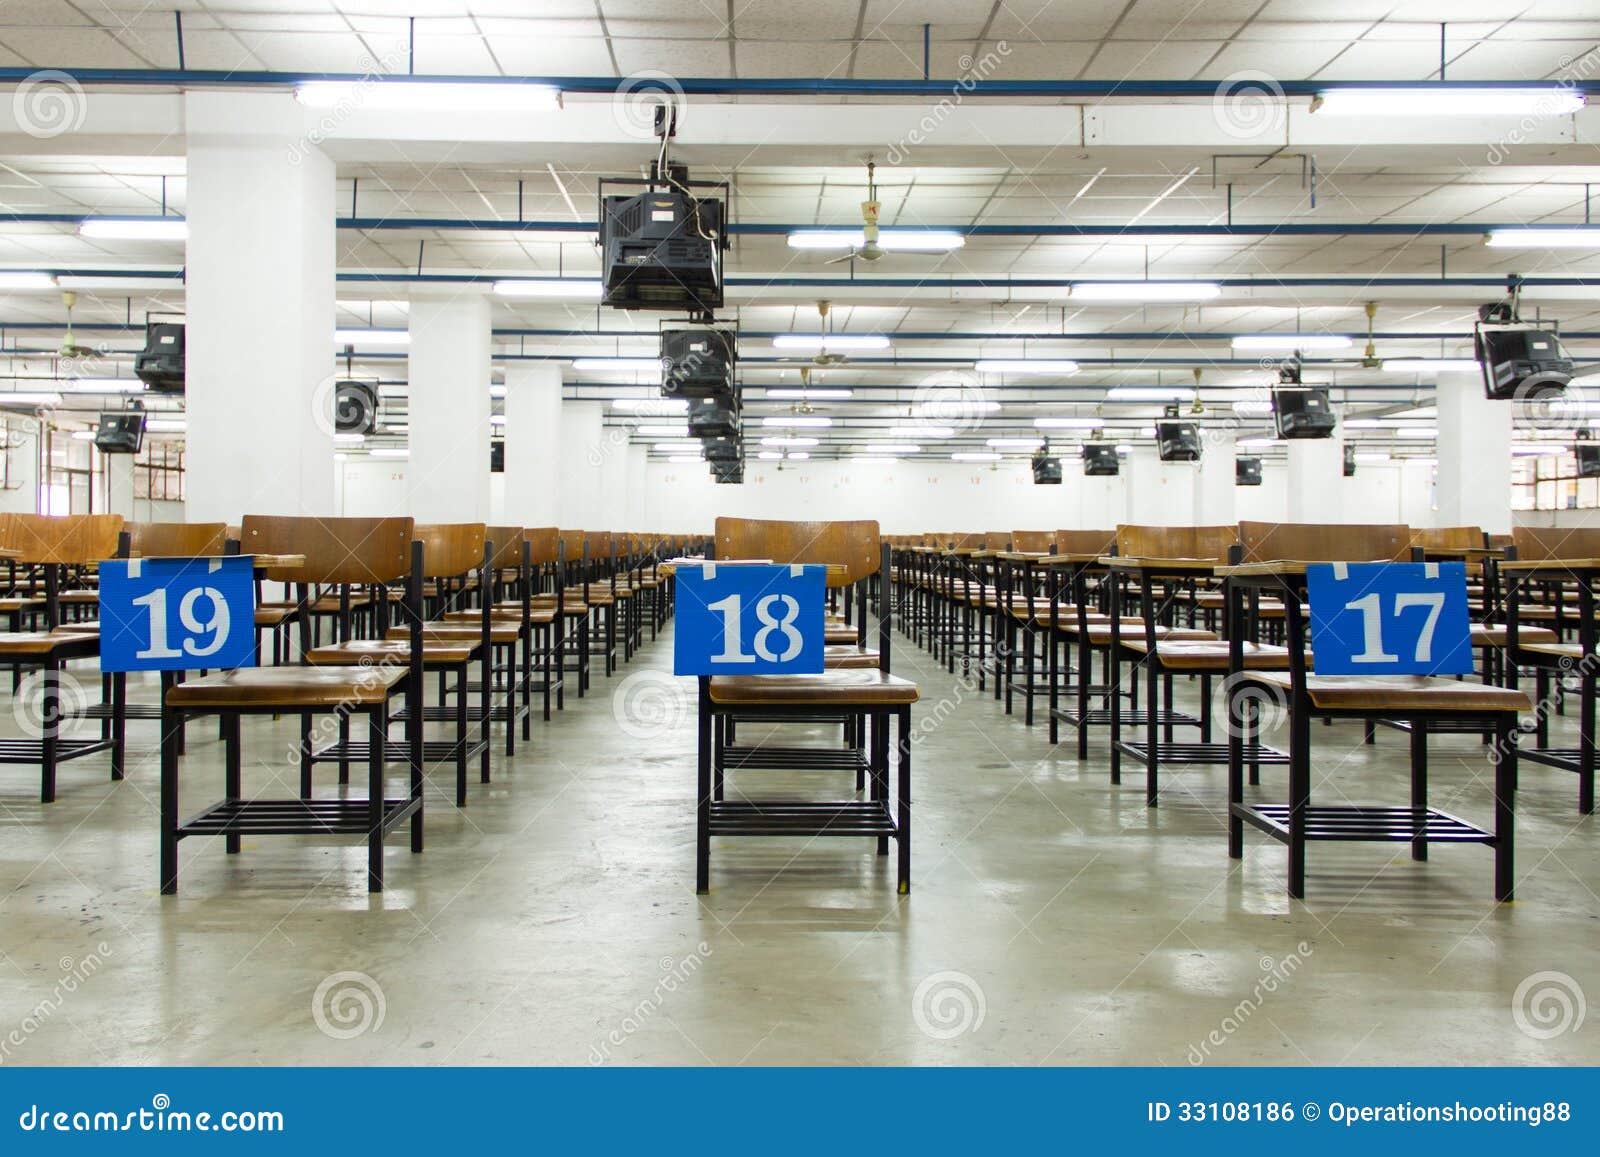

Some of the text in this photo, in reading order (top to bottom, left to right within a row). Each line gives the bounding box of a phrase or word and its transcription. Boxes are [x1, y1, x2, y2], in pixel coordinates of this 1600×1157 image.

[132, 586, 231, 659] 19
[707, 593, 804, 664] 18
[1345, 592, 1446, 663] 17
